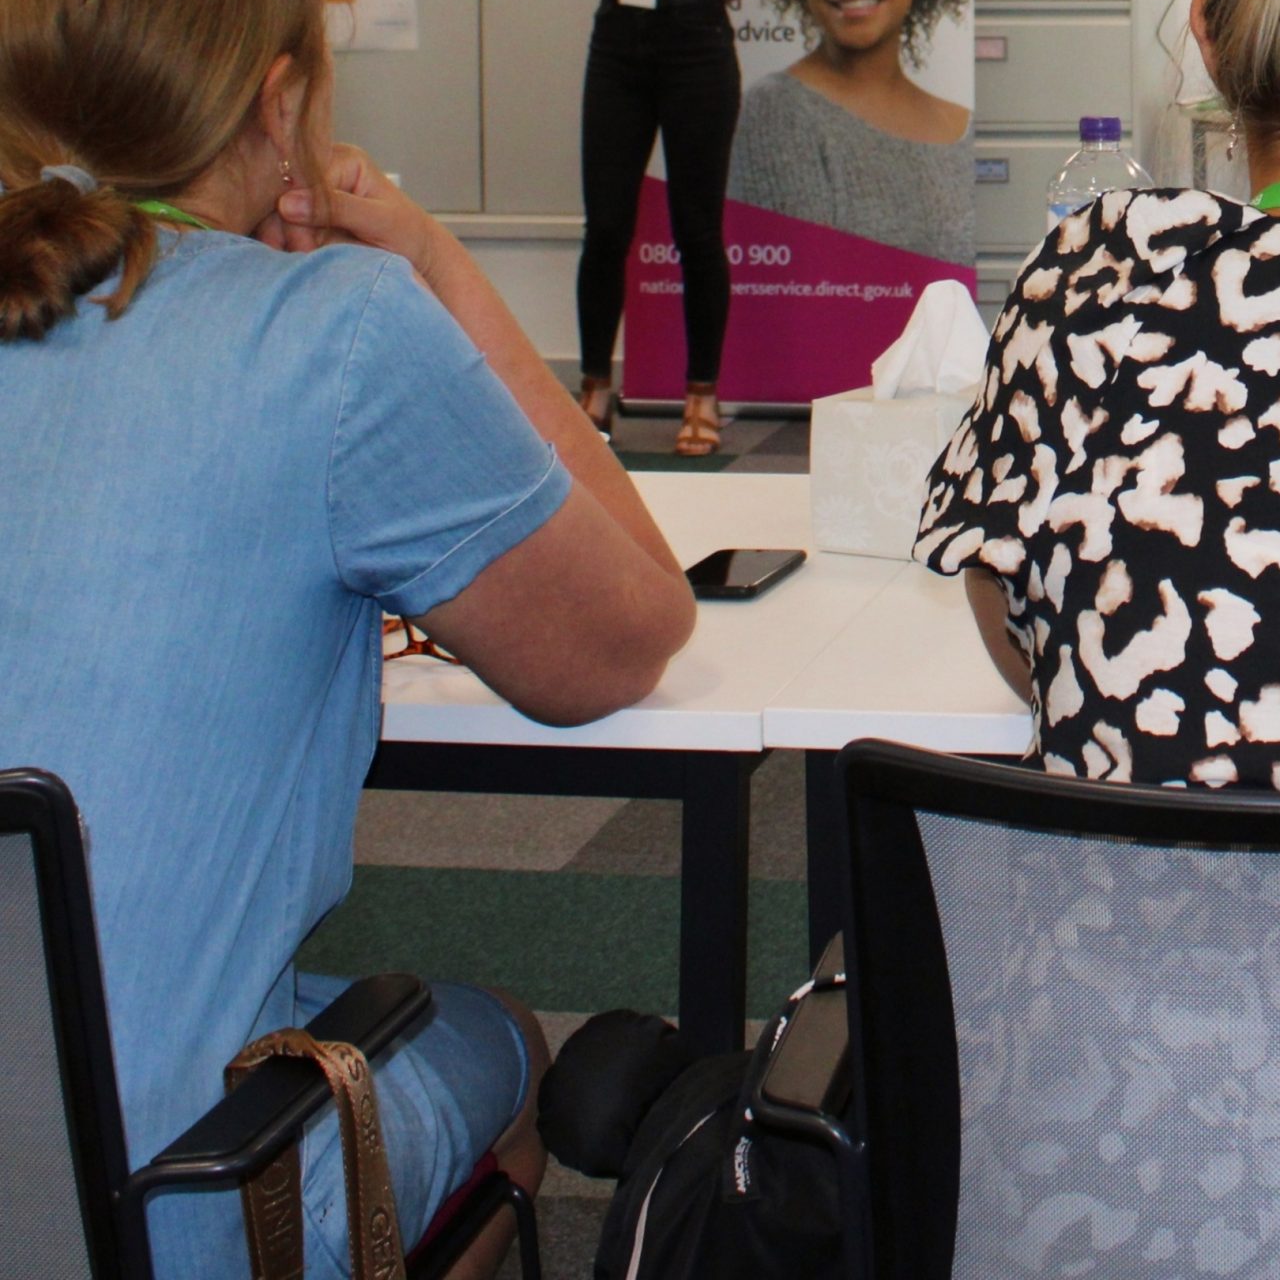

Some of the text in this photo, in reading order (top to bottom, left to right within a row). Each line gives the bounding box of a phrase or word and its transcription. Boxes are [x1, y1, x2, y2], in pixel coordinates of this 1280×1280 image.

[738, 20, 795, 42] dvice
[640, 244, 681, 264] 080
[748, 245, 791, 265] 900
